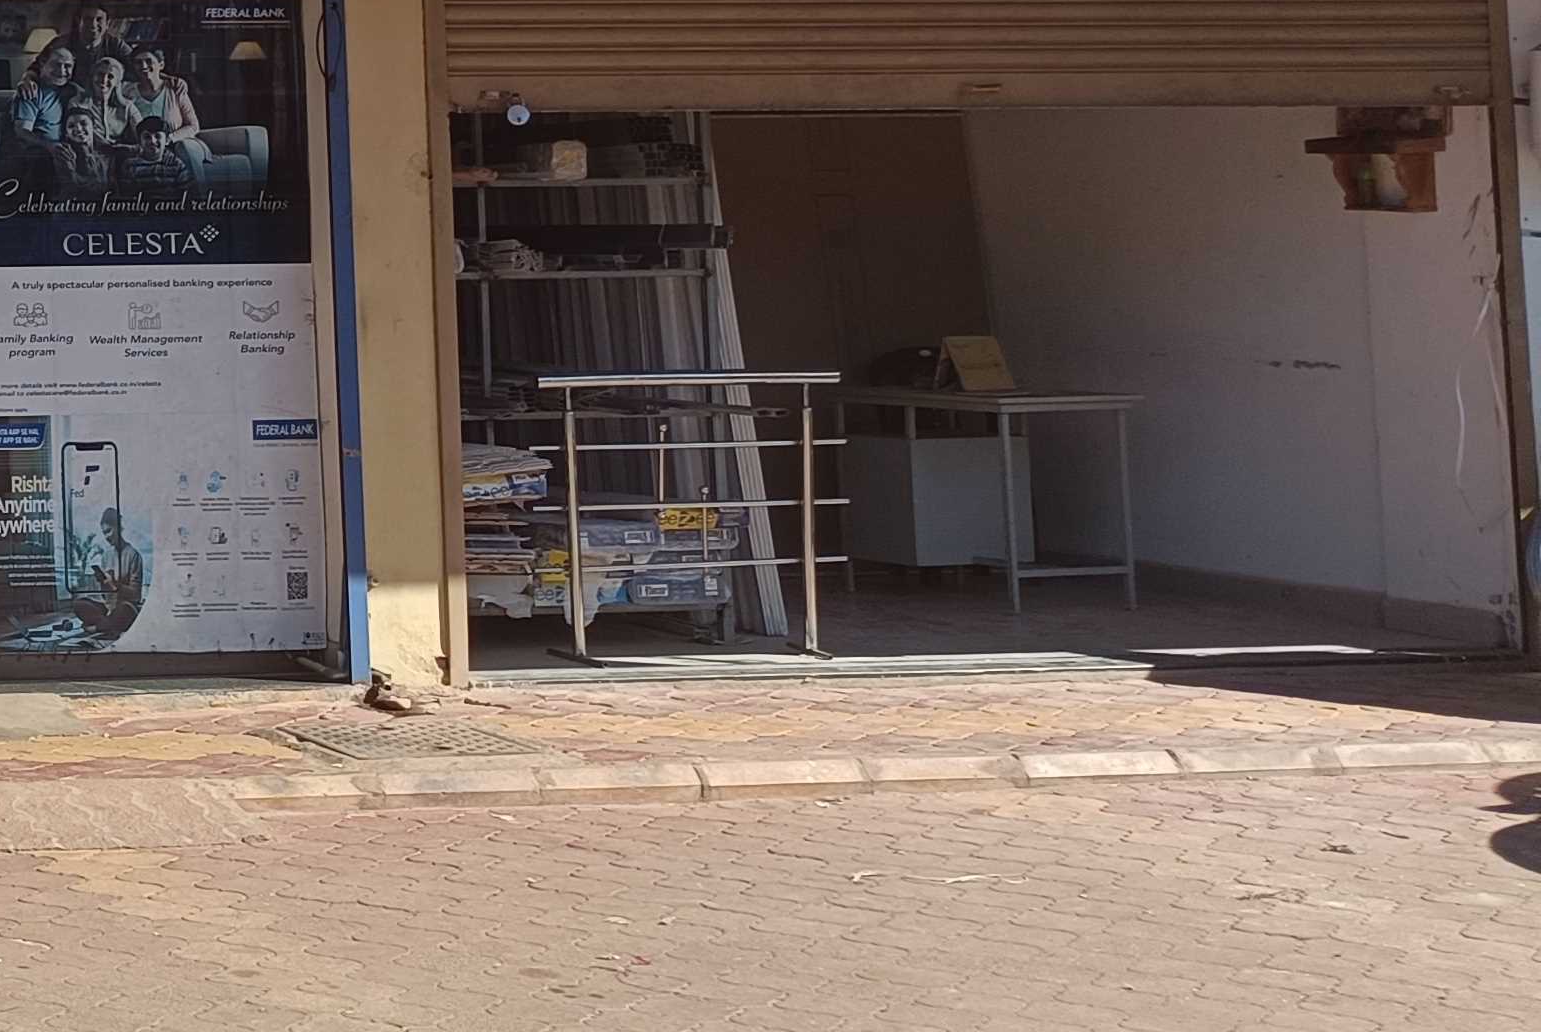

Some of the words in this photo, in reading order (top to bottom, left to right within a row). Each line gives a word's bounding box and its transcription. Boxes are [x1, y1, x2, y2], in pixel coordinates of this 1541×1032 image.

[204, 8, 252, 18] FEDERAL
[254, 8, 286, 18] BANK
[100, 191, 149, 216] family
[155, 191, 185, 212] and
[190, 191, 289, 214] relationships
[63, 231, 204, 256] CELESTA
[12, 280, 21, 290] A
[22, 280, 44, 292] truly
[47, 279, 104, 291] spectacular
[107, 278, 170, 290] personalised
[173, 278, 214, 290] banking
[217, 278, 273, 289] experience
[29, 333, 74, 345] Banking
[89, 334, 128, 345] Wealth
[131, 334, 203, 346] Management
[229, 330, 296, 343] Relationship
[9, 347, 56, 359] program
[124, 347, 169, 359] Services
[240, 344, 285, 355] Banking
